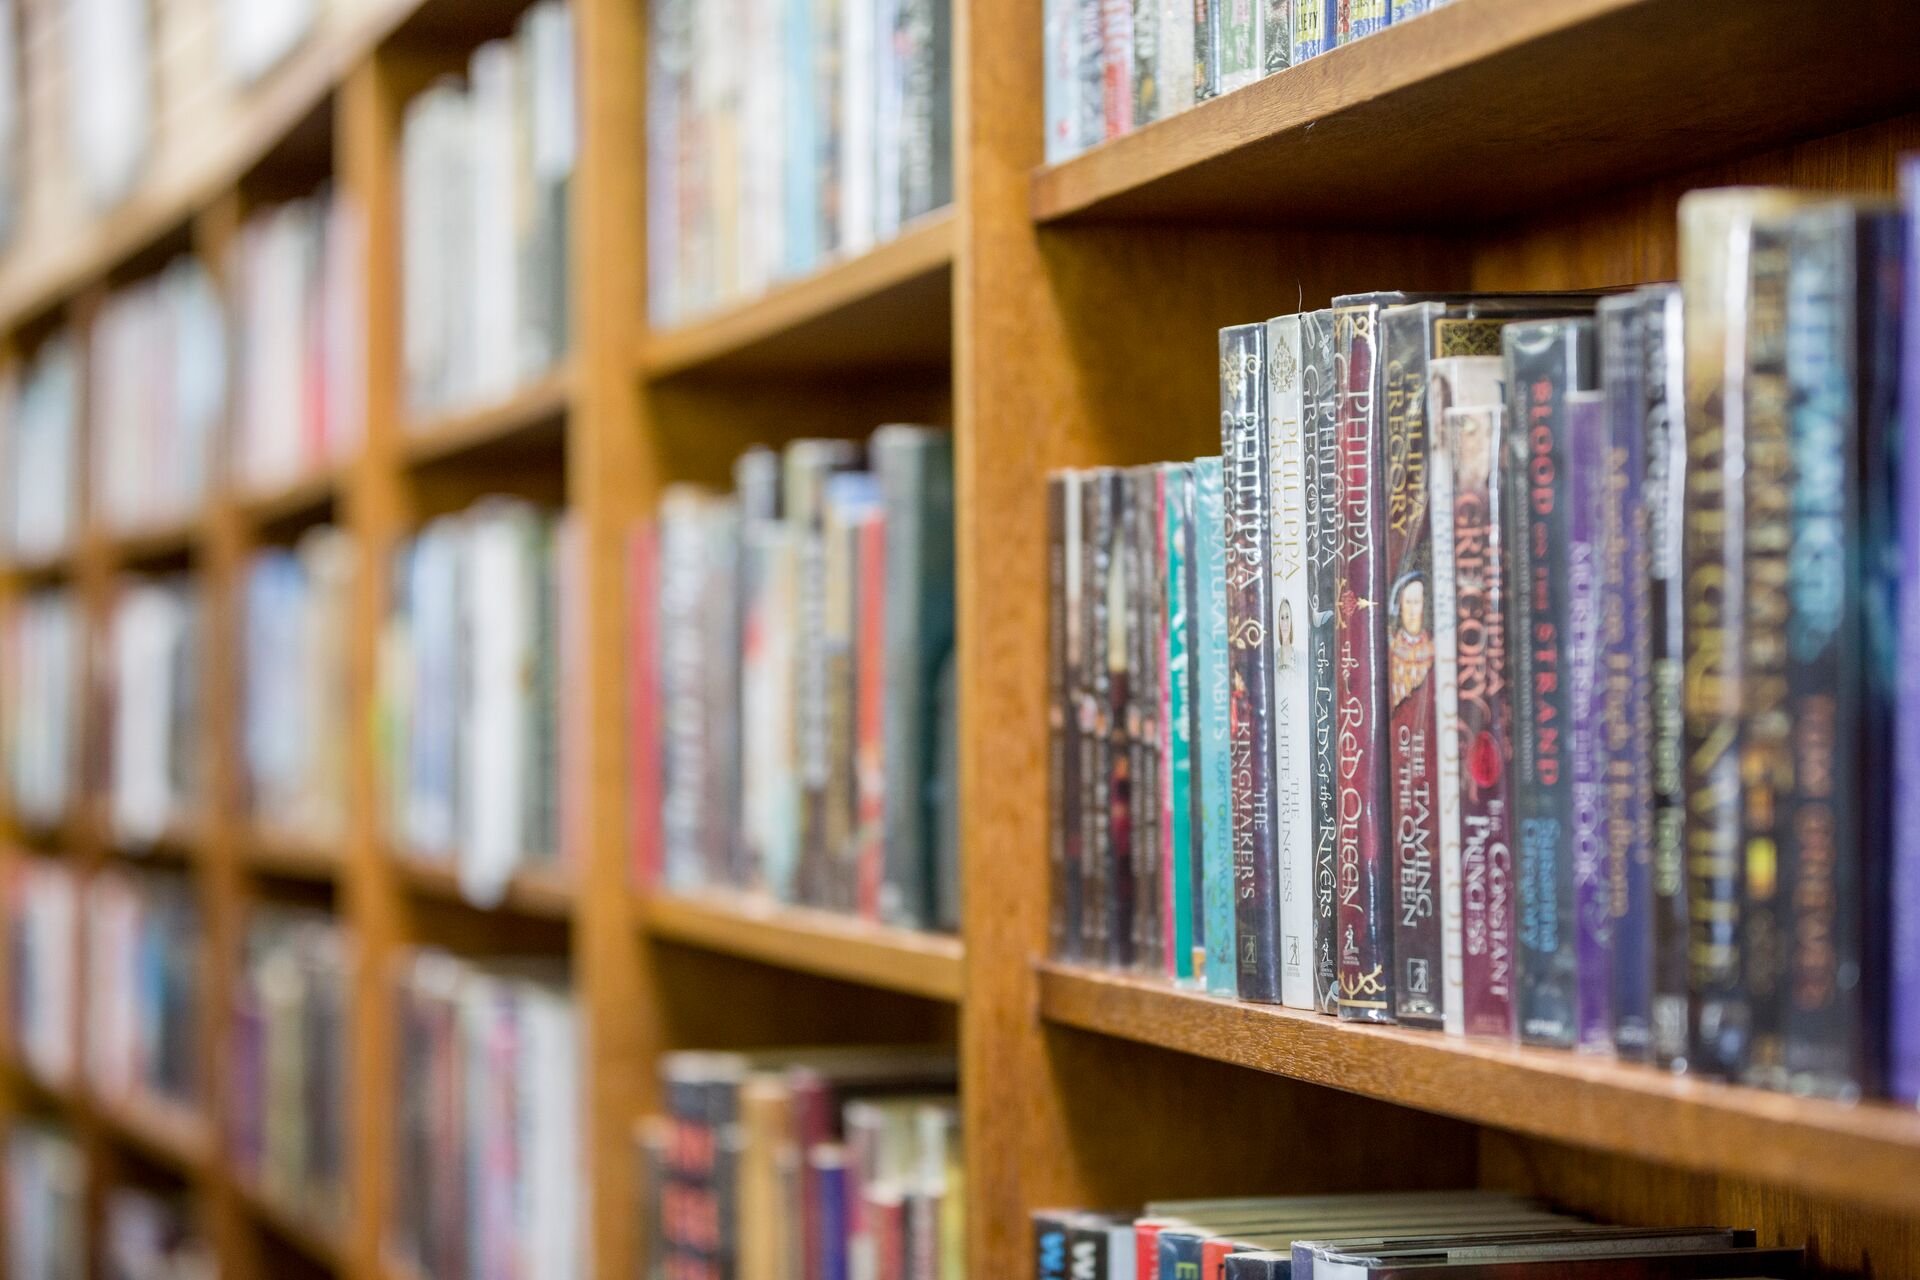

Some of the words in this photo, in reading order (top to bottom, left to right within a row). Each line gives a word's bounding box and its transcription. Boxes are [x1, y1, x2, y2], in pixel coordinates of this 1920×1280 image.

[1221, 409, 1237, 592] GREGORY
[1235, 411, 1263, 592] PHILIPPA
[1271, 416, 1283, 578] GREGORY
[1282, 419, 1301, 584] PHILIPPA
[1303, 364, 1321, 572] GREGORY
[1318, 401, 1337, 568] PHILIPPA
[1347, 391, 1370, 562] PHILIPPA
[1388, 360, 1408, 537] GREGORY
[1406, 372, 1428, 522] PHILIPPA
[1530, 376, 1556, 515] BLOOD
[1208, 472, 1226, 641] NNATURAL
[1454, 491, 1488, 701] GREGORY
[1212, 648, 1229, 741] HABITS
[1279, 697, 1290, 780] WHITE
[1314, 680, 1332, 772] LADY
[1399, 724, 1412, 757] OF
[1412, 728, 1426, 777] THE
[1535, 622, 1558, 786] STRAND
[1237, 721, 1256, 900] KINGMAKER'S
[1253, 788, 1268, 830] THE
[1280, 784, 1293, 904] PRINCESS
[1291, 776, 1301, 819] THE
[1399, 764, 1412, 810] THE
[1413, 782, 1433, 919] TAMING
[1572, 781, 1600, 888] BOOK
[1315, 811, 1337, 919] RIVERS
[1397, 815, 1418, 929] QUEEN
[1463, 815, 1490, 956] PRINCESS
[1488, 842, 1511, 1001] CONSTANT
[1519, 817, 1540, 950] Gregory
[1537, 817, 1560, 953] Susanna
